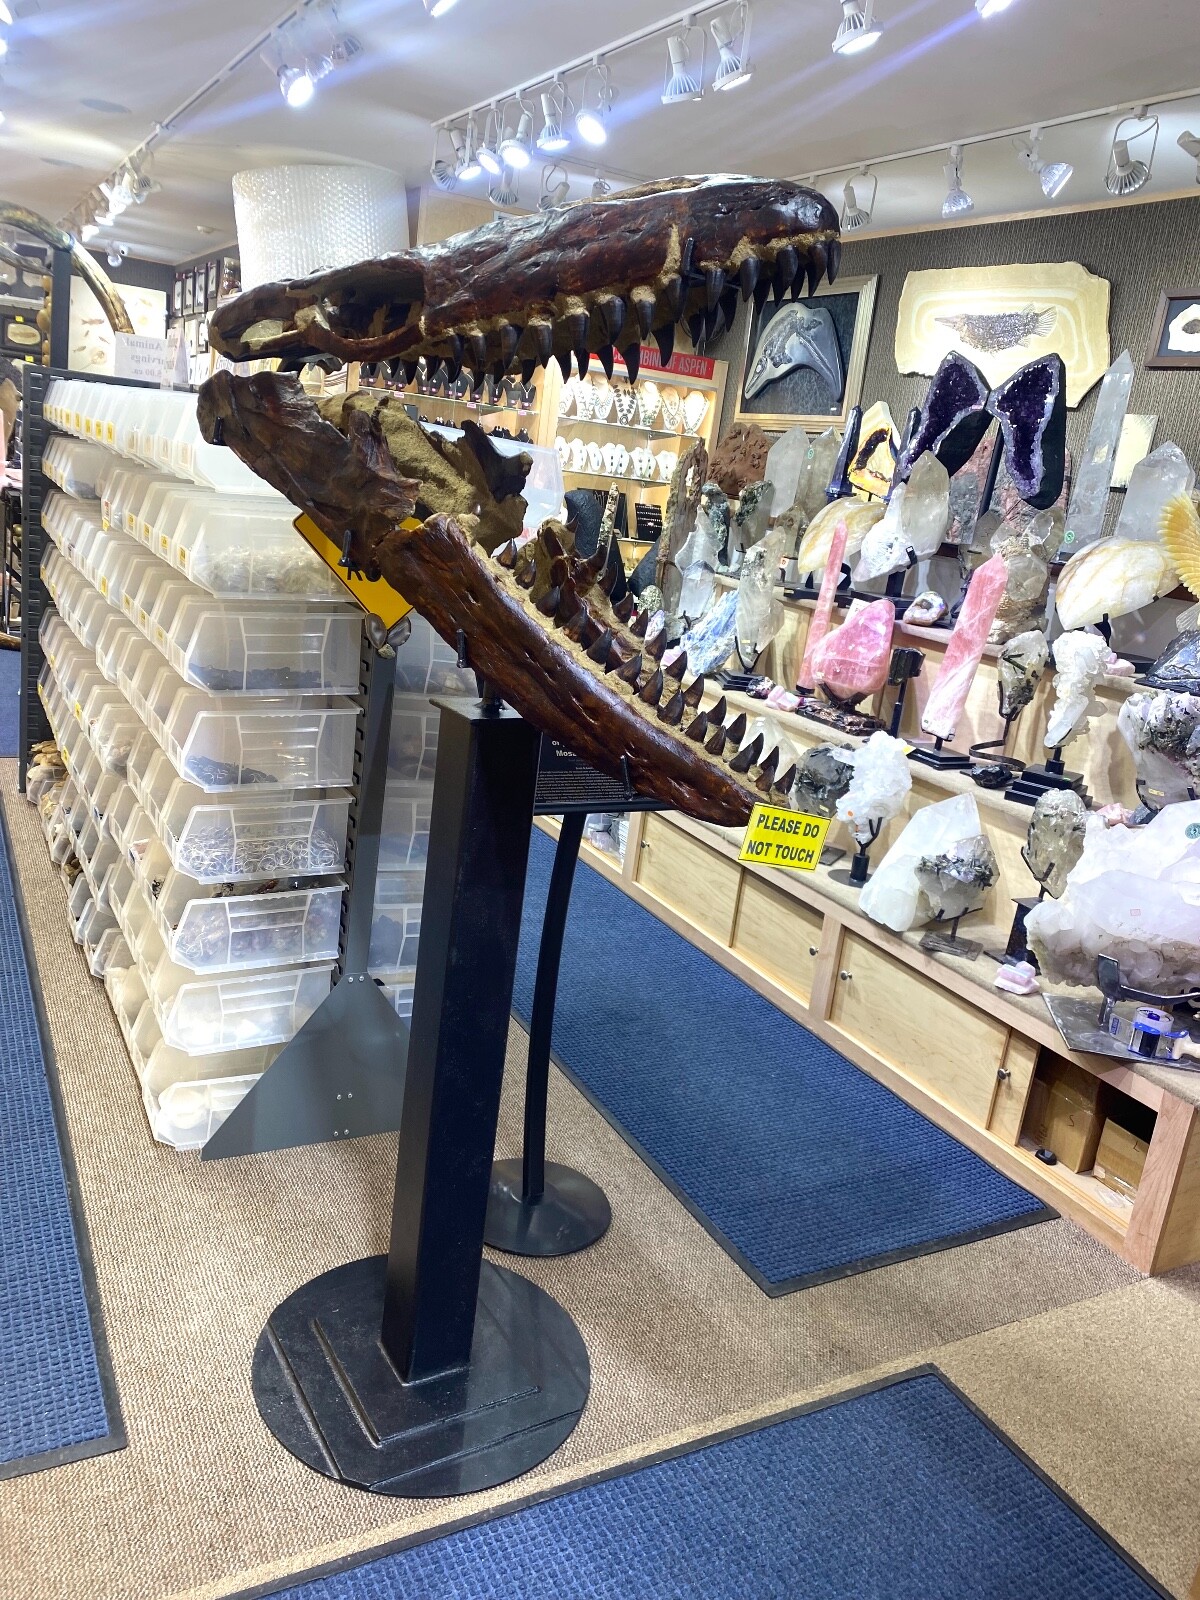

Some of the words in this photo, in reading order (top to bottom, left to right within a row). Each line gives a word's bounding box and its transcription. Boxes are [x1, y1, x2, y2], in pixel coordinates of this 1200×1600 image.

[679, 357, 708, 375] ASPEN
[757, 814, 802, 835] PLEASE
[803, 823, 820, 838] DO
[746, 840, 773, 857] NOT
[775, 844, 815, 863] TOUCH
